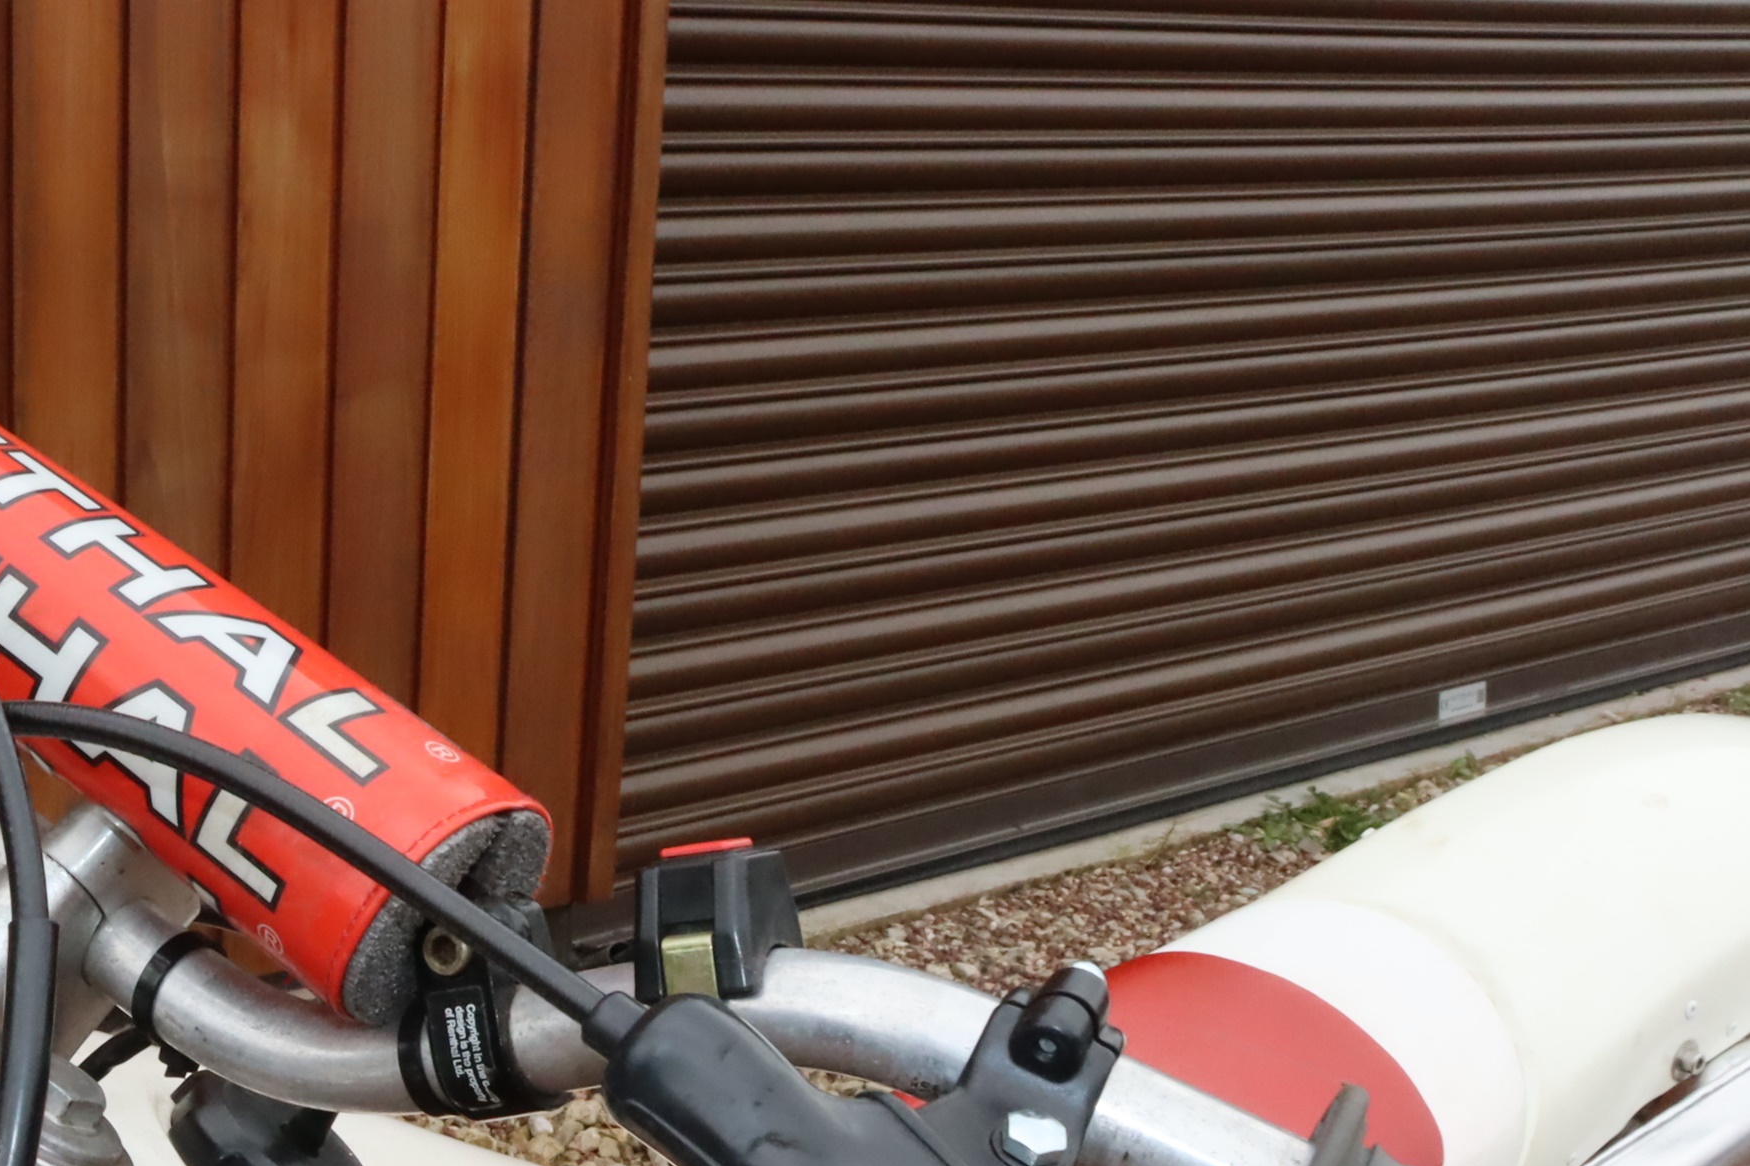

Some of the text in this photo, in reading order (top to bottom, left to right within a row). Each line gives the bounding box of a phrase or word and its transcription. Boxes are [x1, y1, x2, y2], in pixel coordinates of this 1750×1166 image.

[444, 1007, 455, 1018] of
[454, 1005, 467, 1039] design
[466, 1003, 481, 1051] Copyright
[446, 1019, 460, 1058] Renthal
[460, 1040, 469, 1050] is
[461, 1050, 471, 1067] the
[473, 1052, 483, 1063] in
